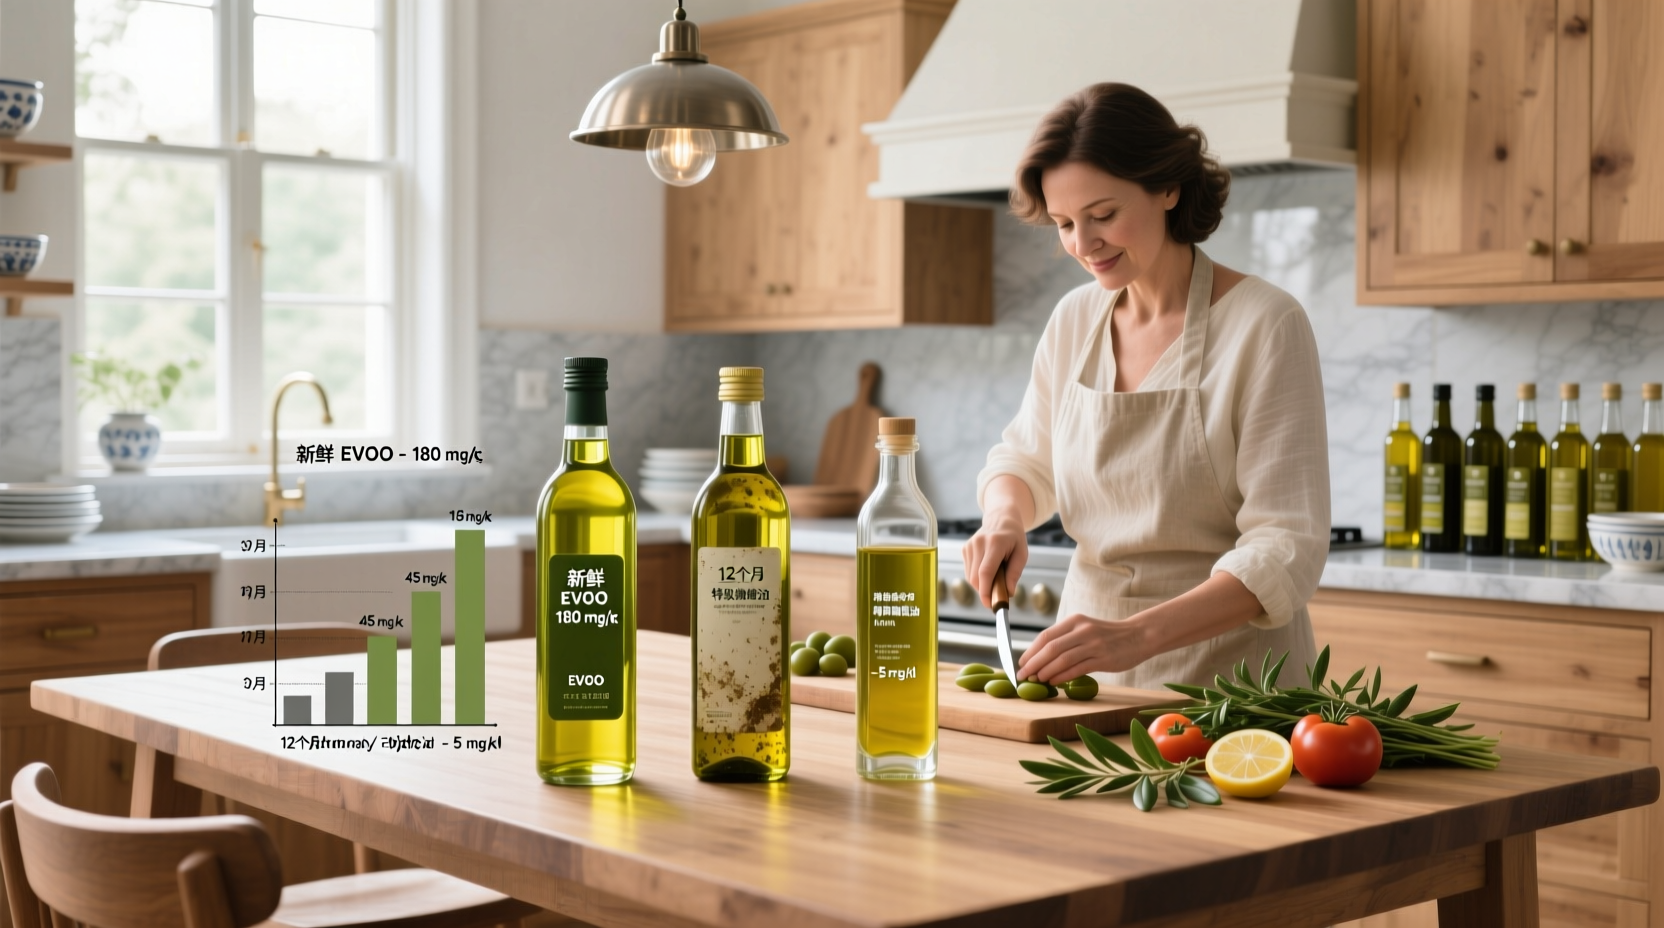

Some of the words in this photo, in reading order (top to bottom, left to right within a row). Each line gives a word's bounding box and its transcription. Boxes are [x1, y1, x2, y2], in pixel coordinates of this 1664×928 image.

[567, 568, 605, 588] 新鲜
[718, 566, 764, 583] 12个月
[561, 591, 608, 606] EVOO
[555, 610, 581, 624] 180
[568, 674, 605, 687] EVOO
